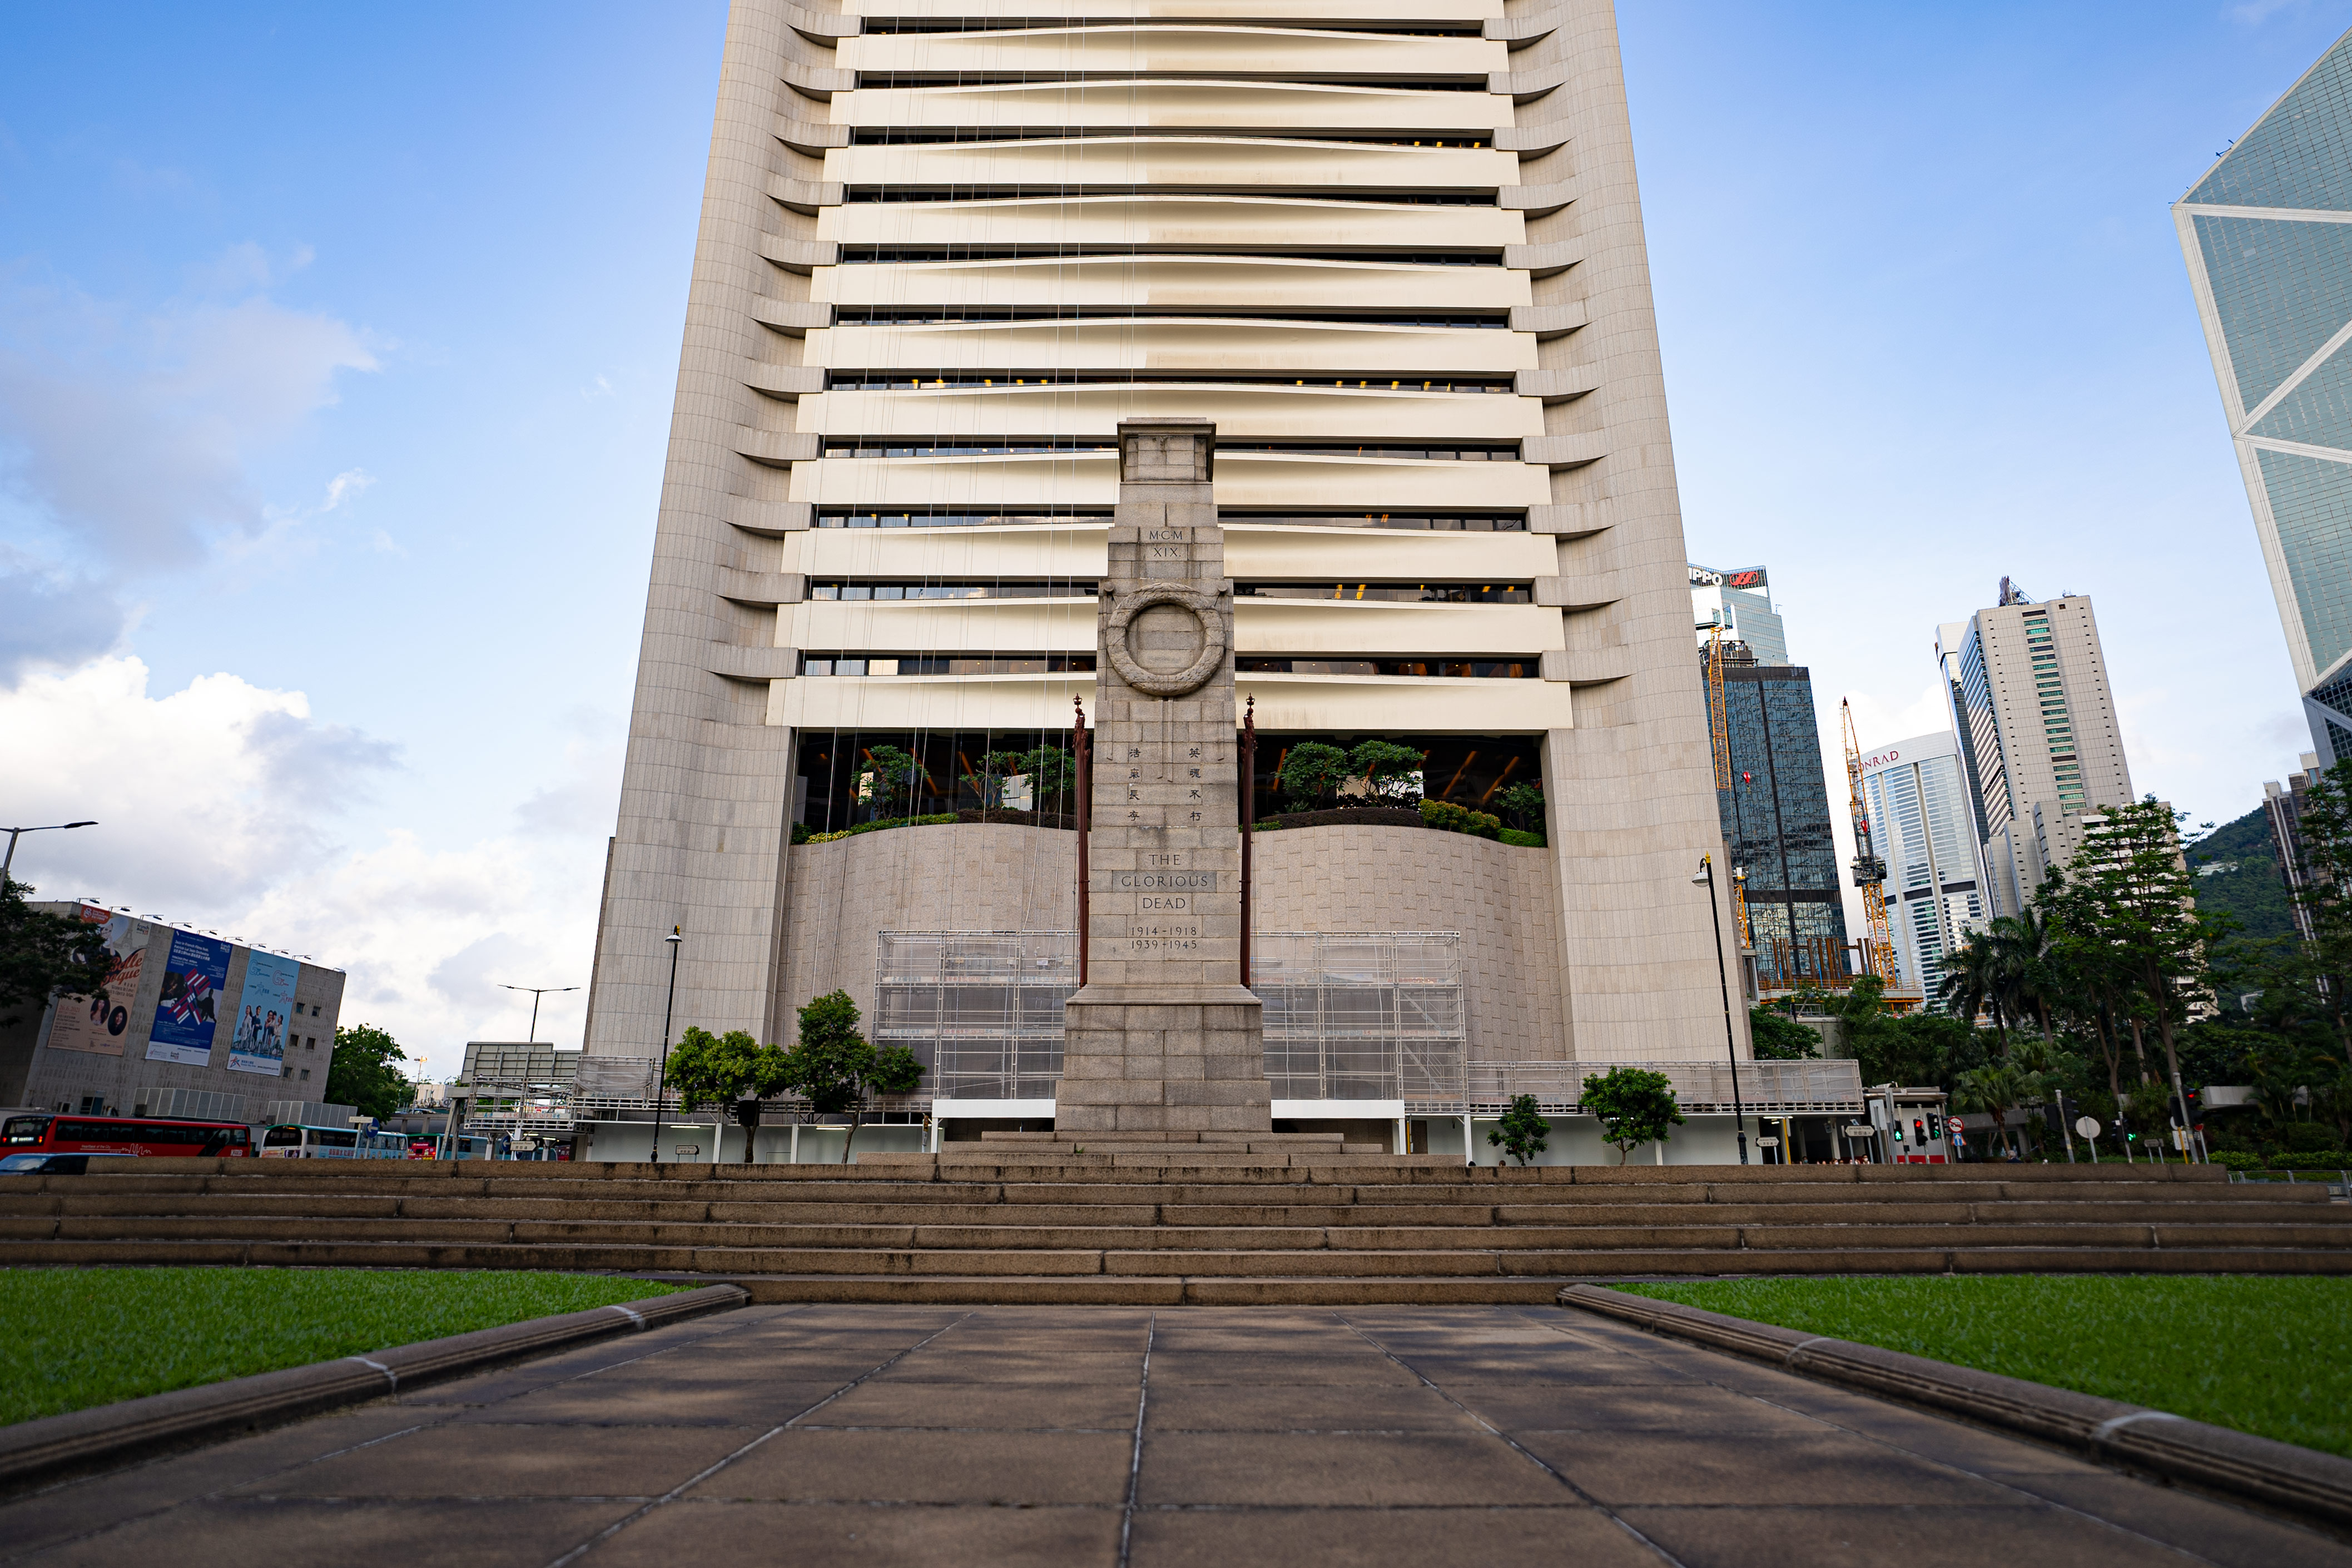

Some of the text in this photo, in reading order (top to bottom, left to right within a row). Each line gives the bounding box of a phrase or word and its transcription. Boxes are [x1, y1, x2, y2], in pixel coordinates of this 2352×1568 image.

[1688, 567, 1723, 587] IPPO
[1857, 751, 1899, 772] ONRAD
[1189, 747, 1202, 822] 英魂不朽
[1148, 854, 1180, 865] THE
[1122, 876, 1208, 887] GLORIOUS
[1143, 897, 1185, 909] DEAD
[100, 969, 141, 988] poque
